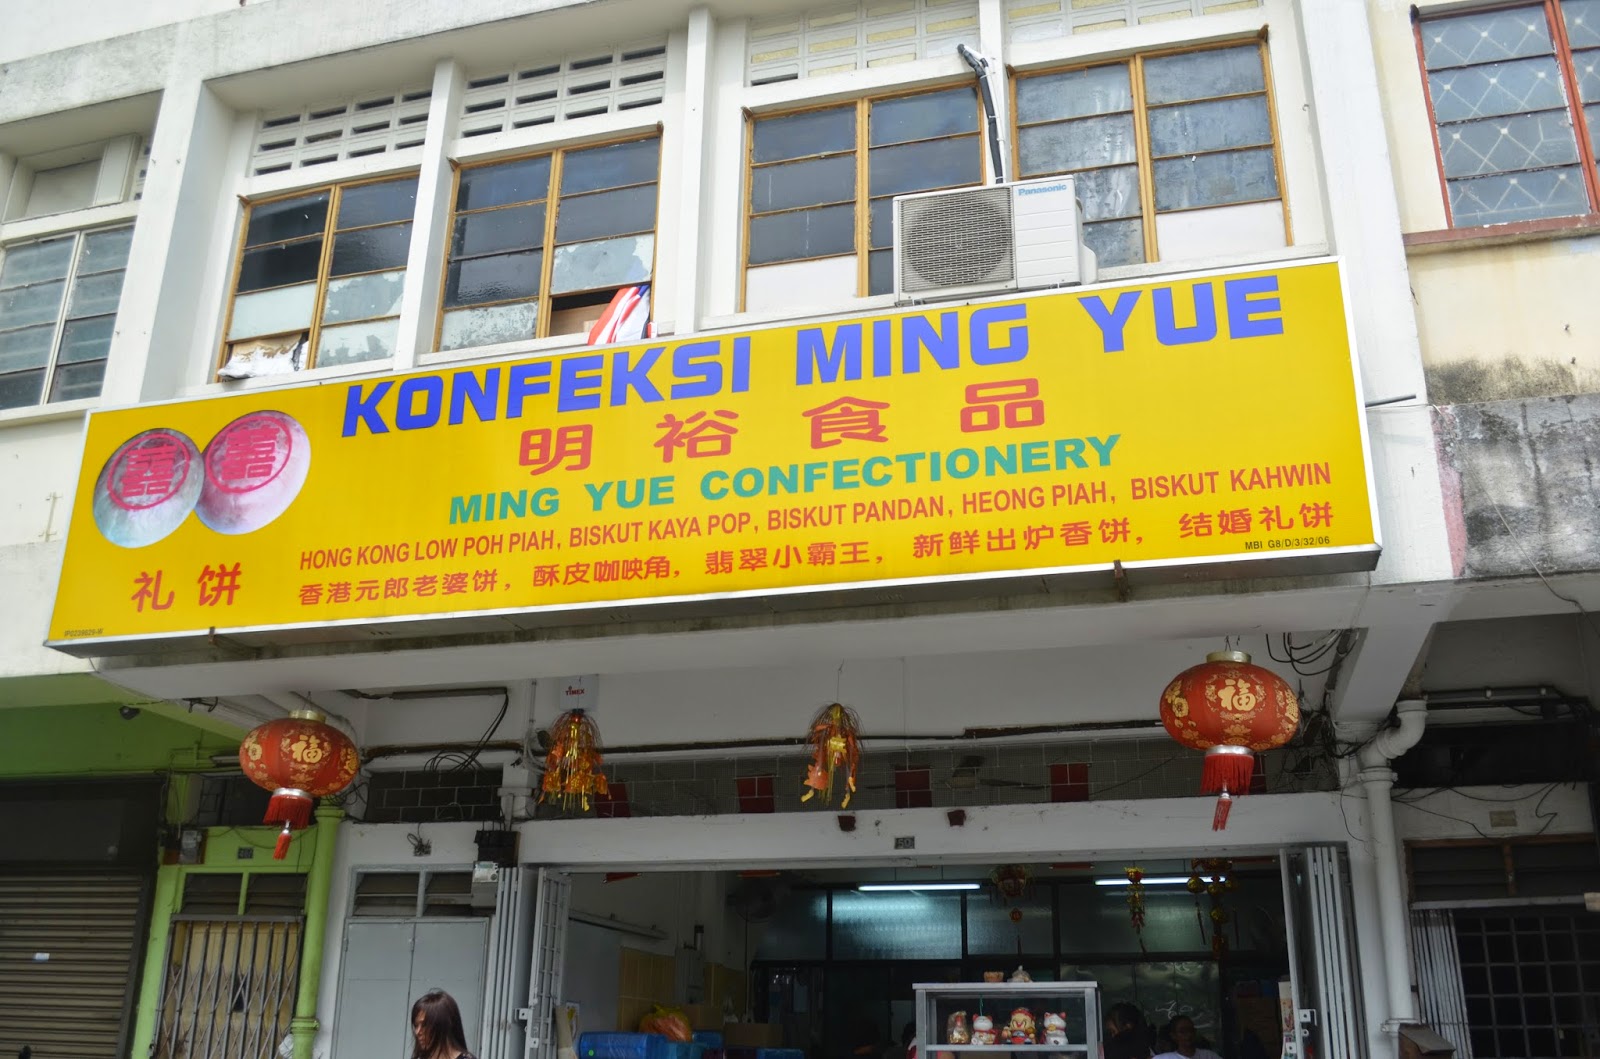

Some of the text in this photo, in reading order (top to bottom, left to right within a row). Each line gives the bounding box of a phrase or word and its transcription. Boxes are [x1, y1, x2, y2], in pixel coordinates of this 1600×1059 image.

[1018, 184, 1067, 195] Panasonic
[341, 275, 1284, 438] KONFEKSI MING YUE
[518, 378, 1046, 476] 明裕食品
[449, 433, 1121, 524] MING YUE CONFECTIONERY
[299, 546, 354, 571] HONG
[356, 543, 410, 567] KONG
[414, 537, 459, 561] LOW
[463, 533, 503, 557] POH
[569, 521, 644, 548] BISKUT
[648, 516, 702, 541] KAYA
[767, 503, 847, 531] BISKUT
[962, 486, 1046, 514] HEONG
[1131, 471, 1220, 501] BISKUT
[1230, 461, 1332, 492] KAHWIN
[1178, 501, 1335, 539] 结婚礼饼
[1245, 535, 1330, 550] MBI G8/D/3/32/06
[131, 562, 243, 613] 礼饼
[1218, 678, 1257, 712] 福
[291, 734, 323, 764] 福
